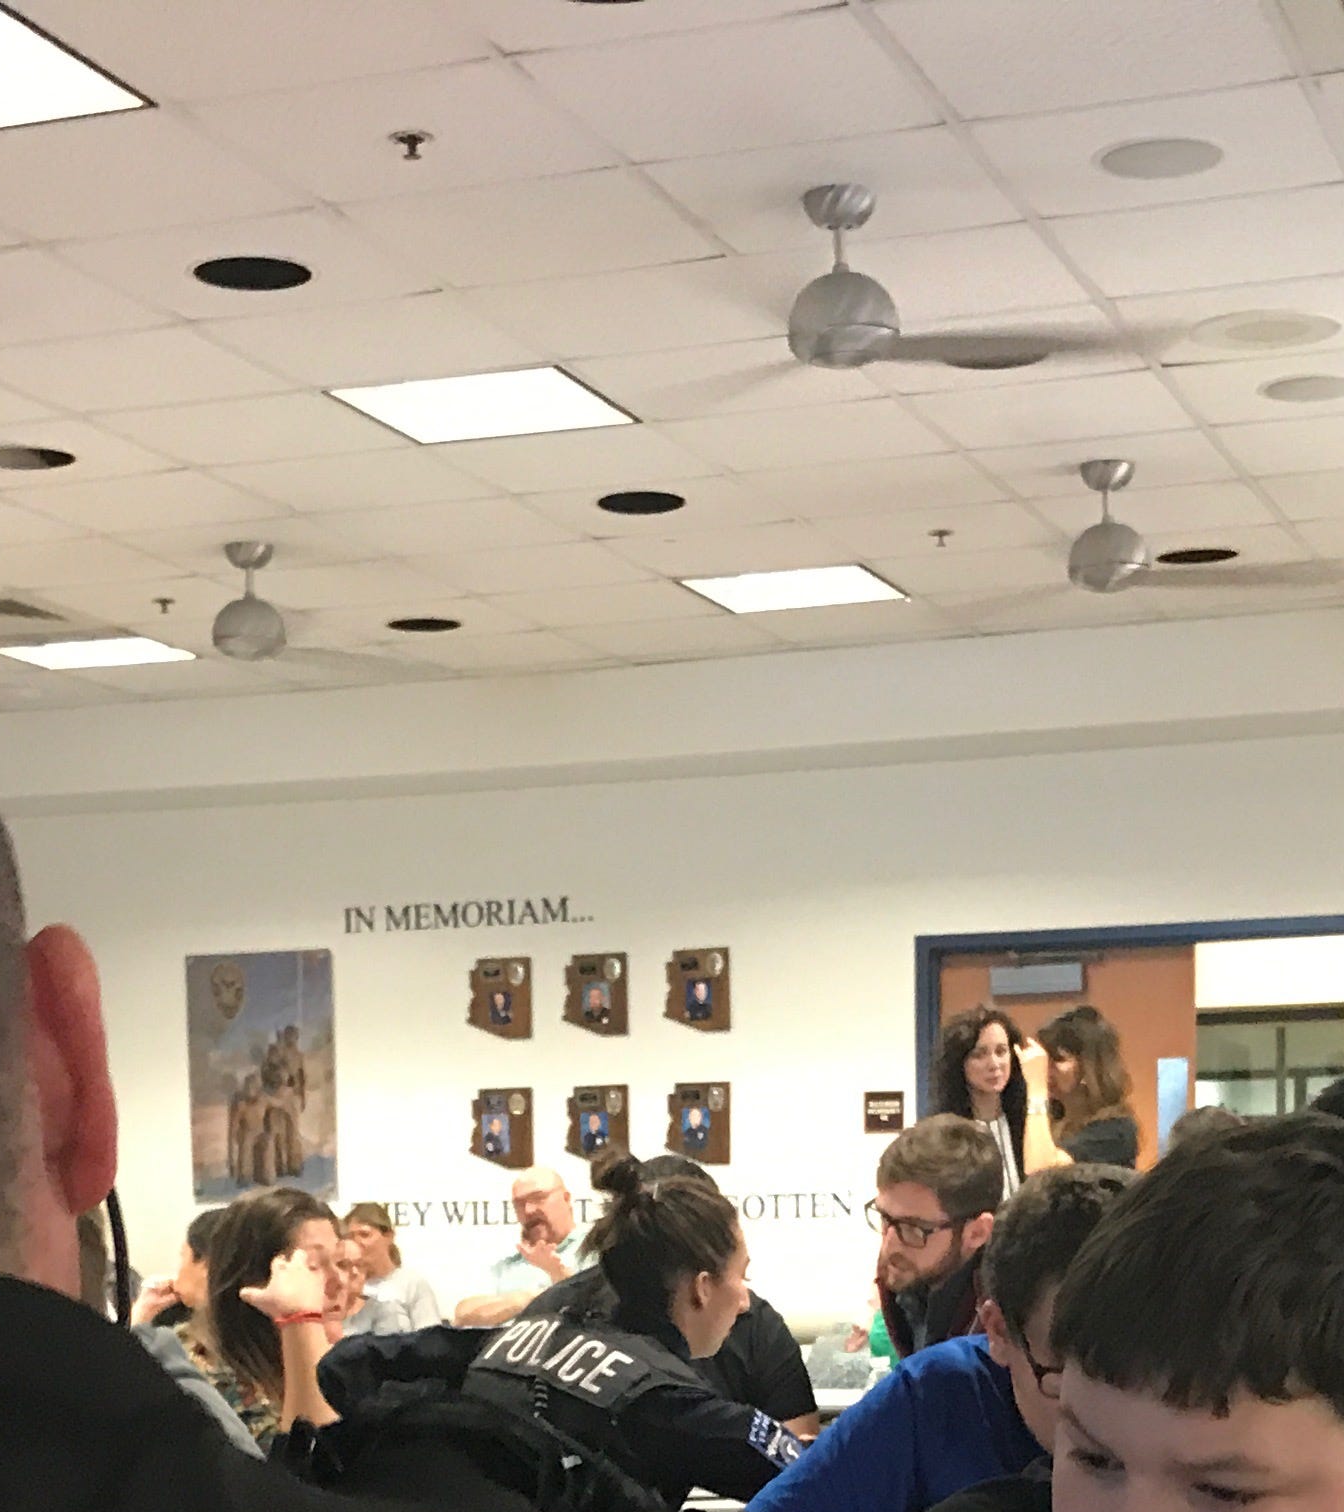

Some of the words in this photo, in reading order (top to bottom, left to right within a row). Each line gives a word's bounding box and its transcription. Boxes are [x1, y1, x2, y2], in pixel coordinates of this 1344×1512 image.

[344, 905, 376, 934] IN
[384, 895, 595, 932] MEMORIAM...
[442, 1200, 519, 1226] WILL
[484, 1319, 634, 1394] POLICE
